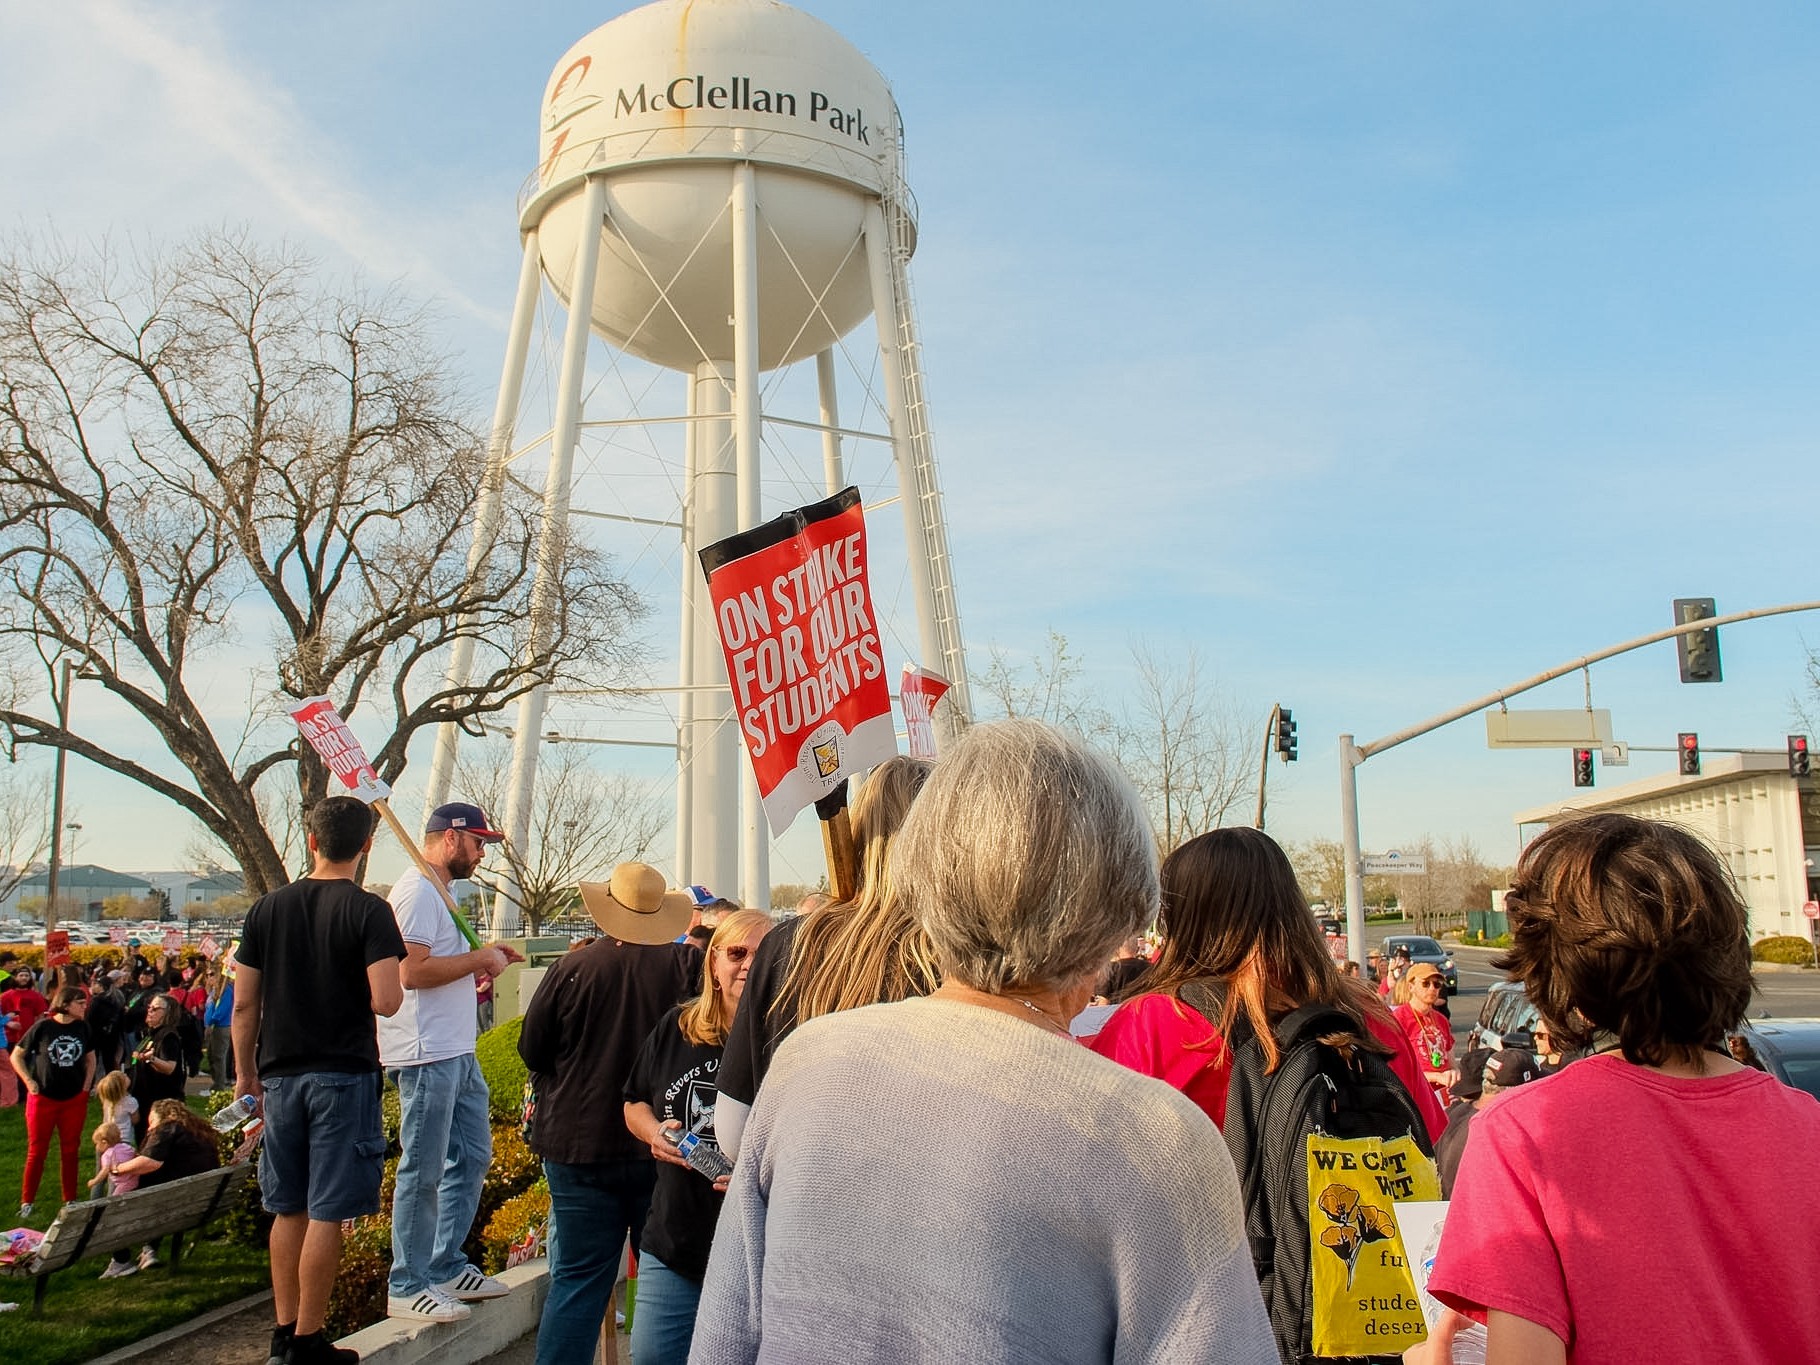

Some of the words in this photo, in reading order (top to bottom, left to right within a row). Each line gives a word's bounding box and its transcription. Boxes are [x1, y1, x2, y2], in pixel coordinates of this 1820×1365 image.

[614, 75, 797, 119] McClellan
[810, 90, 870, 146] Park
[719, 587, 771, 650] ON
[772, 531, 863, 624] STRIKE
[732, 627, 809, 710] FOR
[810, 581, 872, 664] OUR
[743, 634, 883, 759] STUDENTS
[821, 770, 842, 787] TRUE
[665, 1066, 701, 1101] Rivers
[663, 1104, 674, 1119] in
[1312, 1150, 1358, 1170] WE
[1380, 1250, 1408, 1268] fu
[1358, 1293, 1420, 1312] stude
